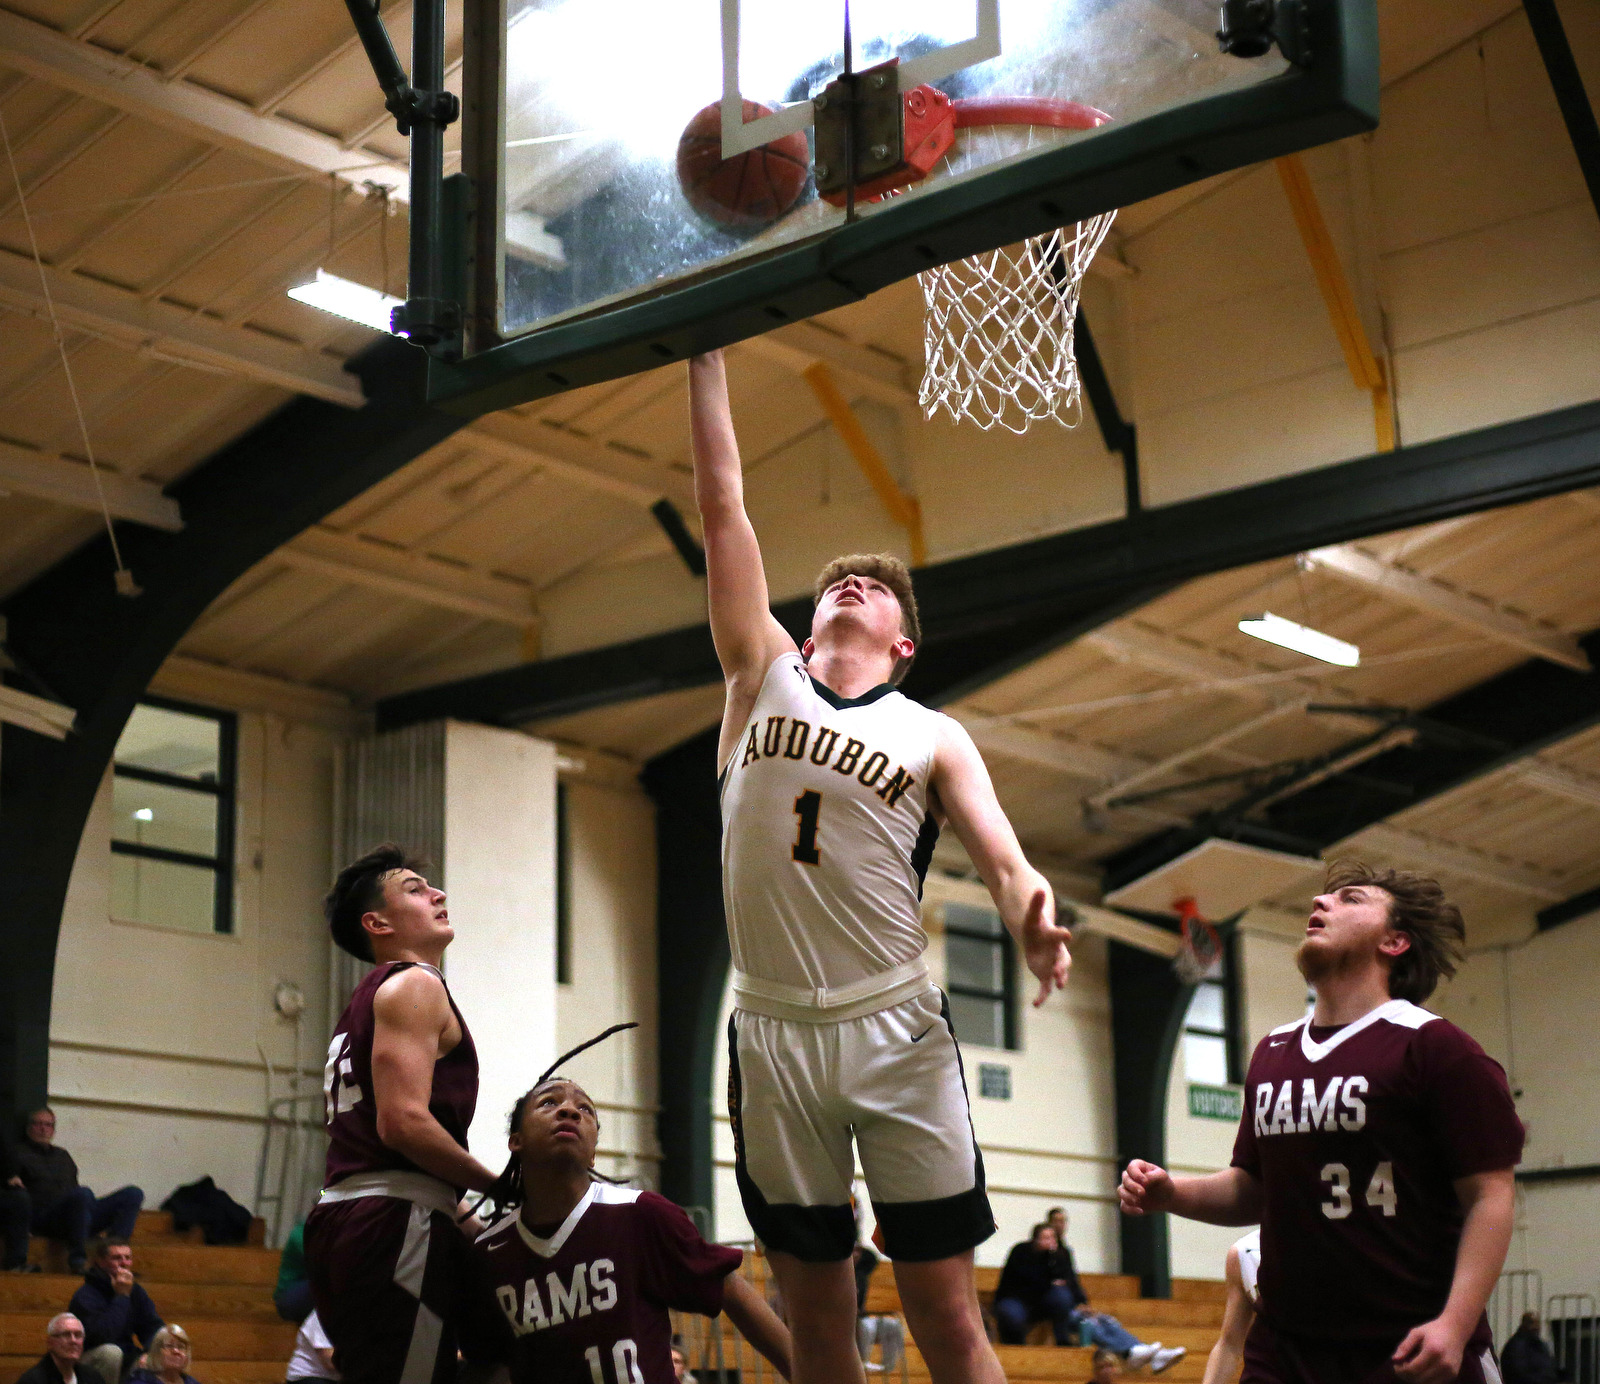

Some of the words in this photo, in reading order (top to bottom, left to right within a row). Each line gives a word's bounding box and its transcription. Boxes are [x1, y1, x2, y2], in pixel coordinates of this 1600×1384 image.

[742, 716, 915, 808] AUDUBON
[792, 788, 823, 866] 1
[1254, 1075, 1369, 1138] RAMS
[1320, 1161, 1397, 1219] 34
[496, 1258, 618, 1338] RAMS
